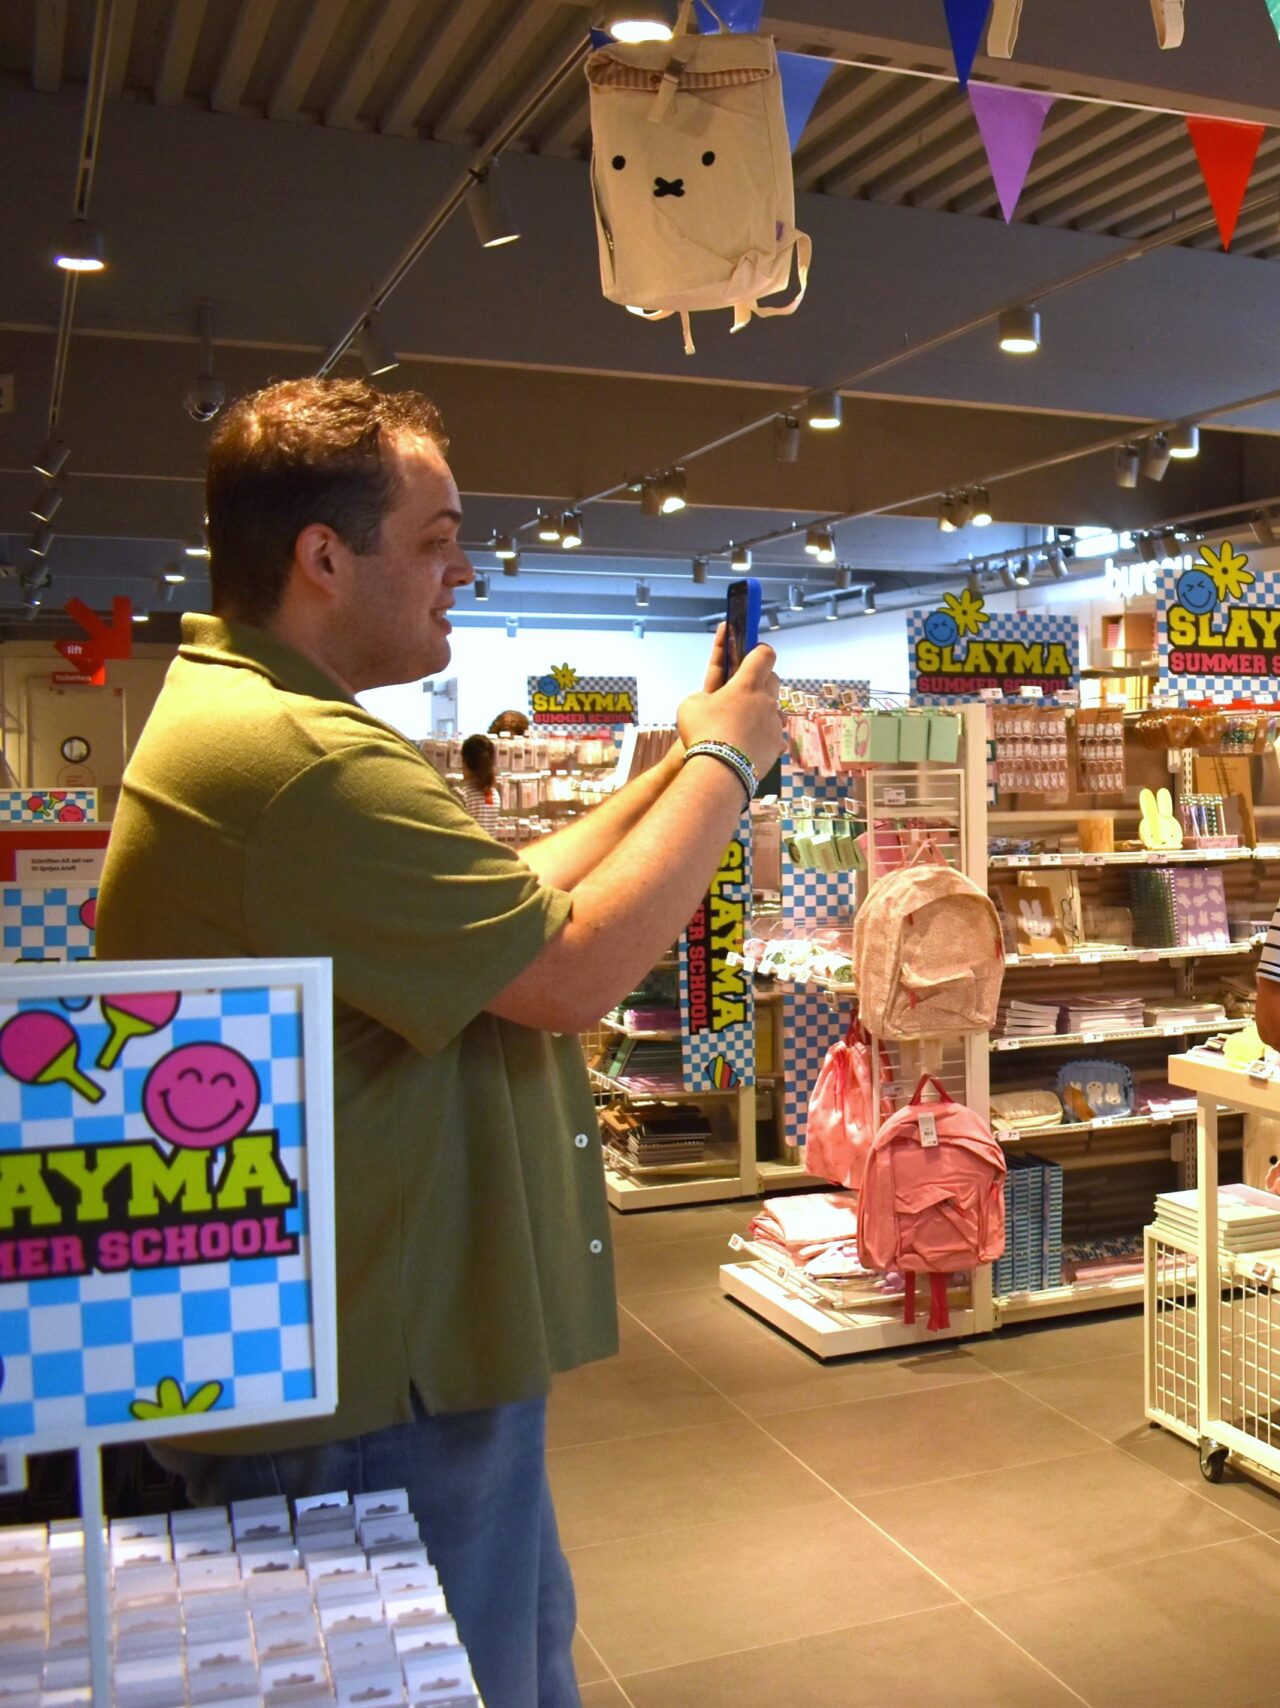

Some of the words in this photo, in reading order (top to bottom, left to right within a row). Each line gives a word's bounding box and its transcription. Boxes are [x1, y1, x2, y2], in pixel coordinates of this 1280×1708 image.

[916, 640, 1071, 675] SLAYMA
[1171, 652, 1267, 674] SUMMER
[533, 692, 633, 712] SLAYMA
[688, 946, 706, 1032] SCHOOL
[97, 1217, 292, 1269] SCHOOL
